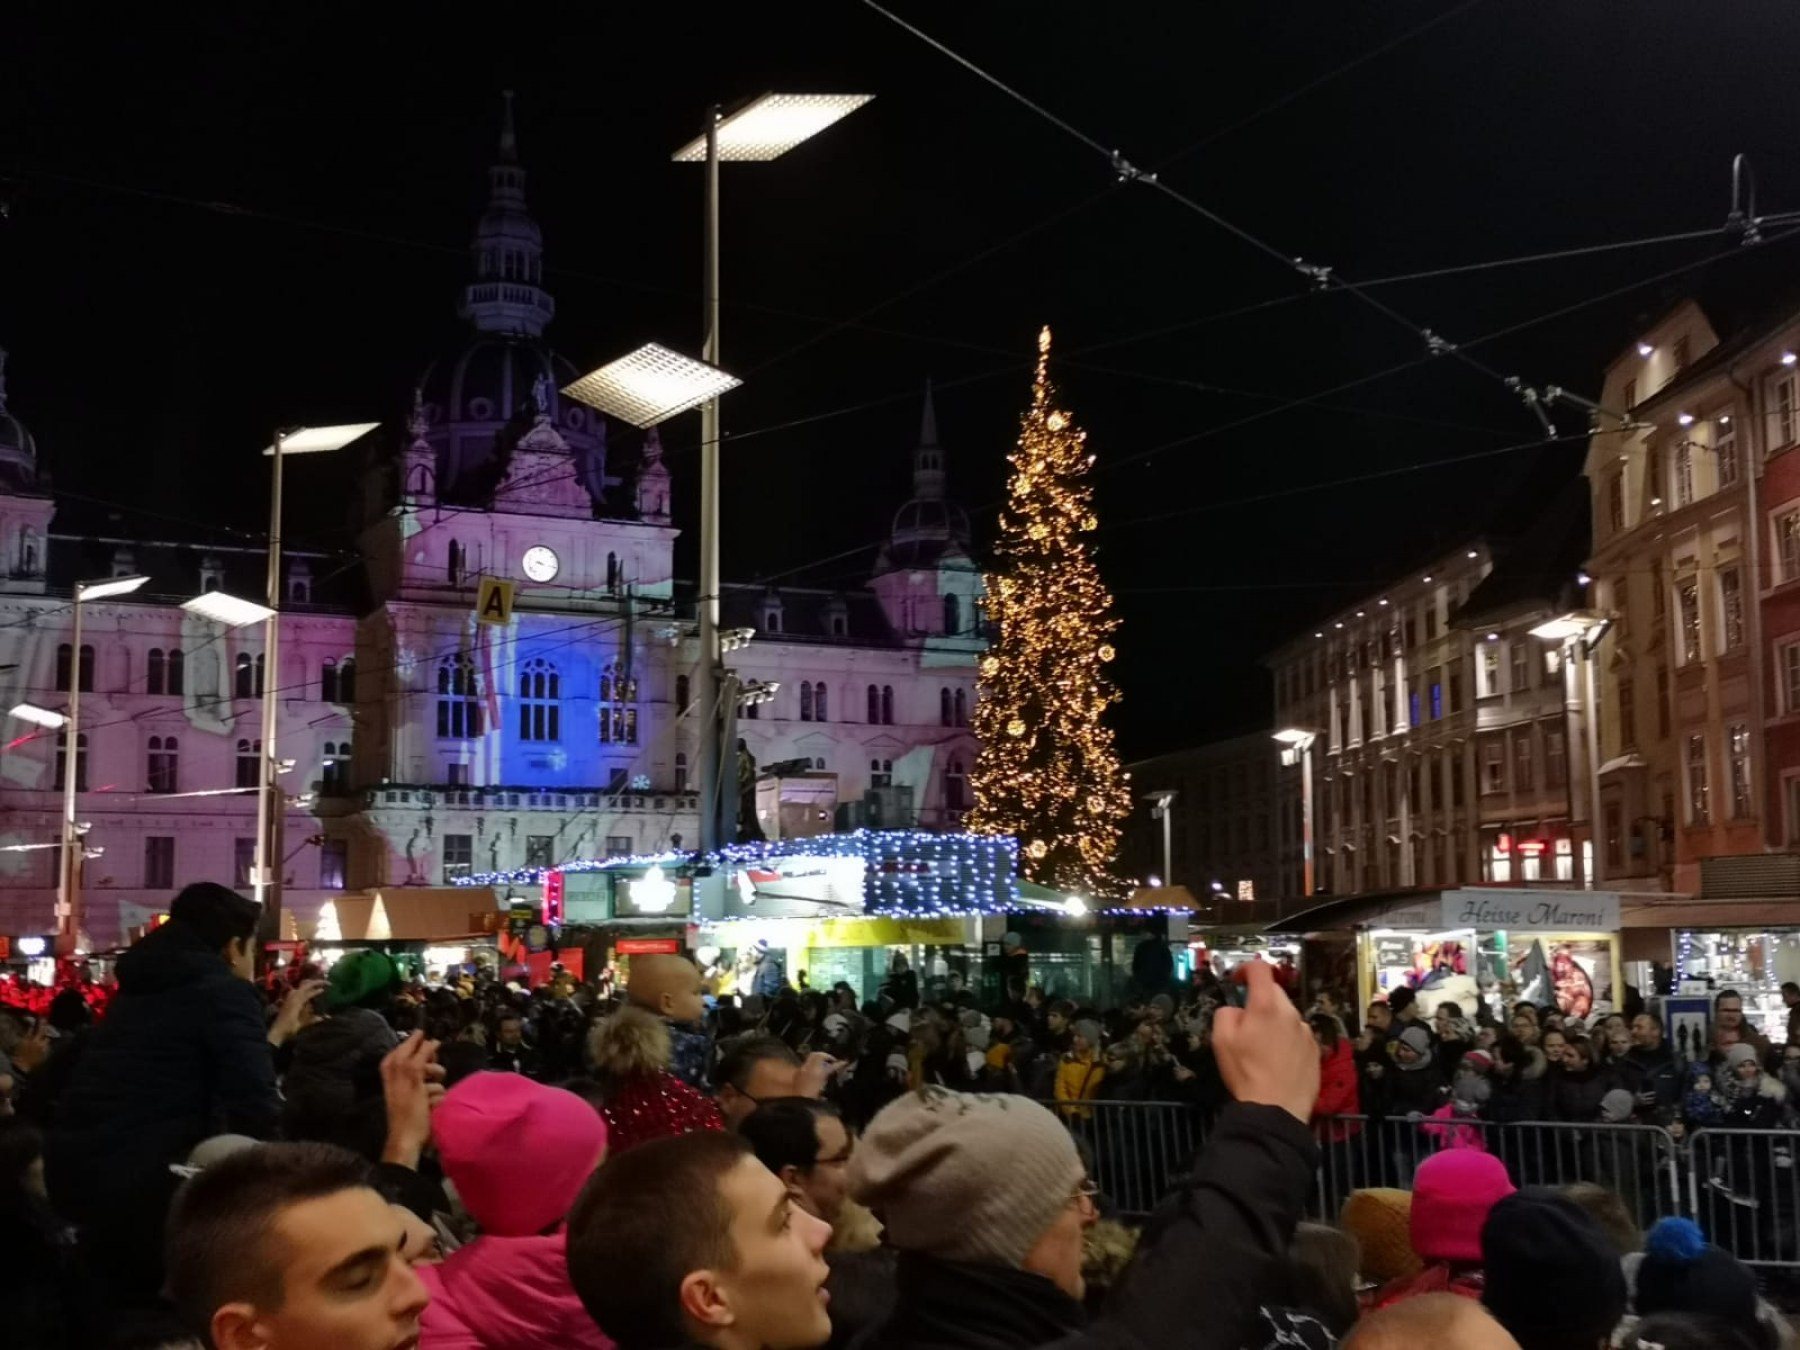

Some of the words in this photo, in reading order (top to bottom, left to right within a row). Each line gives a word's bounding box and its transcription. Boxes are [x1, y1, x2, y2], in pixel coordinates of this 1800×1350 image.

[482, 586, 504, 618] A
[1458, 900, 1522, 925] Heisse
[1527, 902, 1604, 927] Maroni
